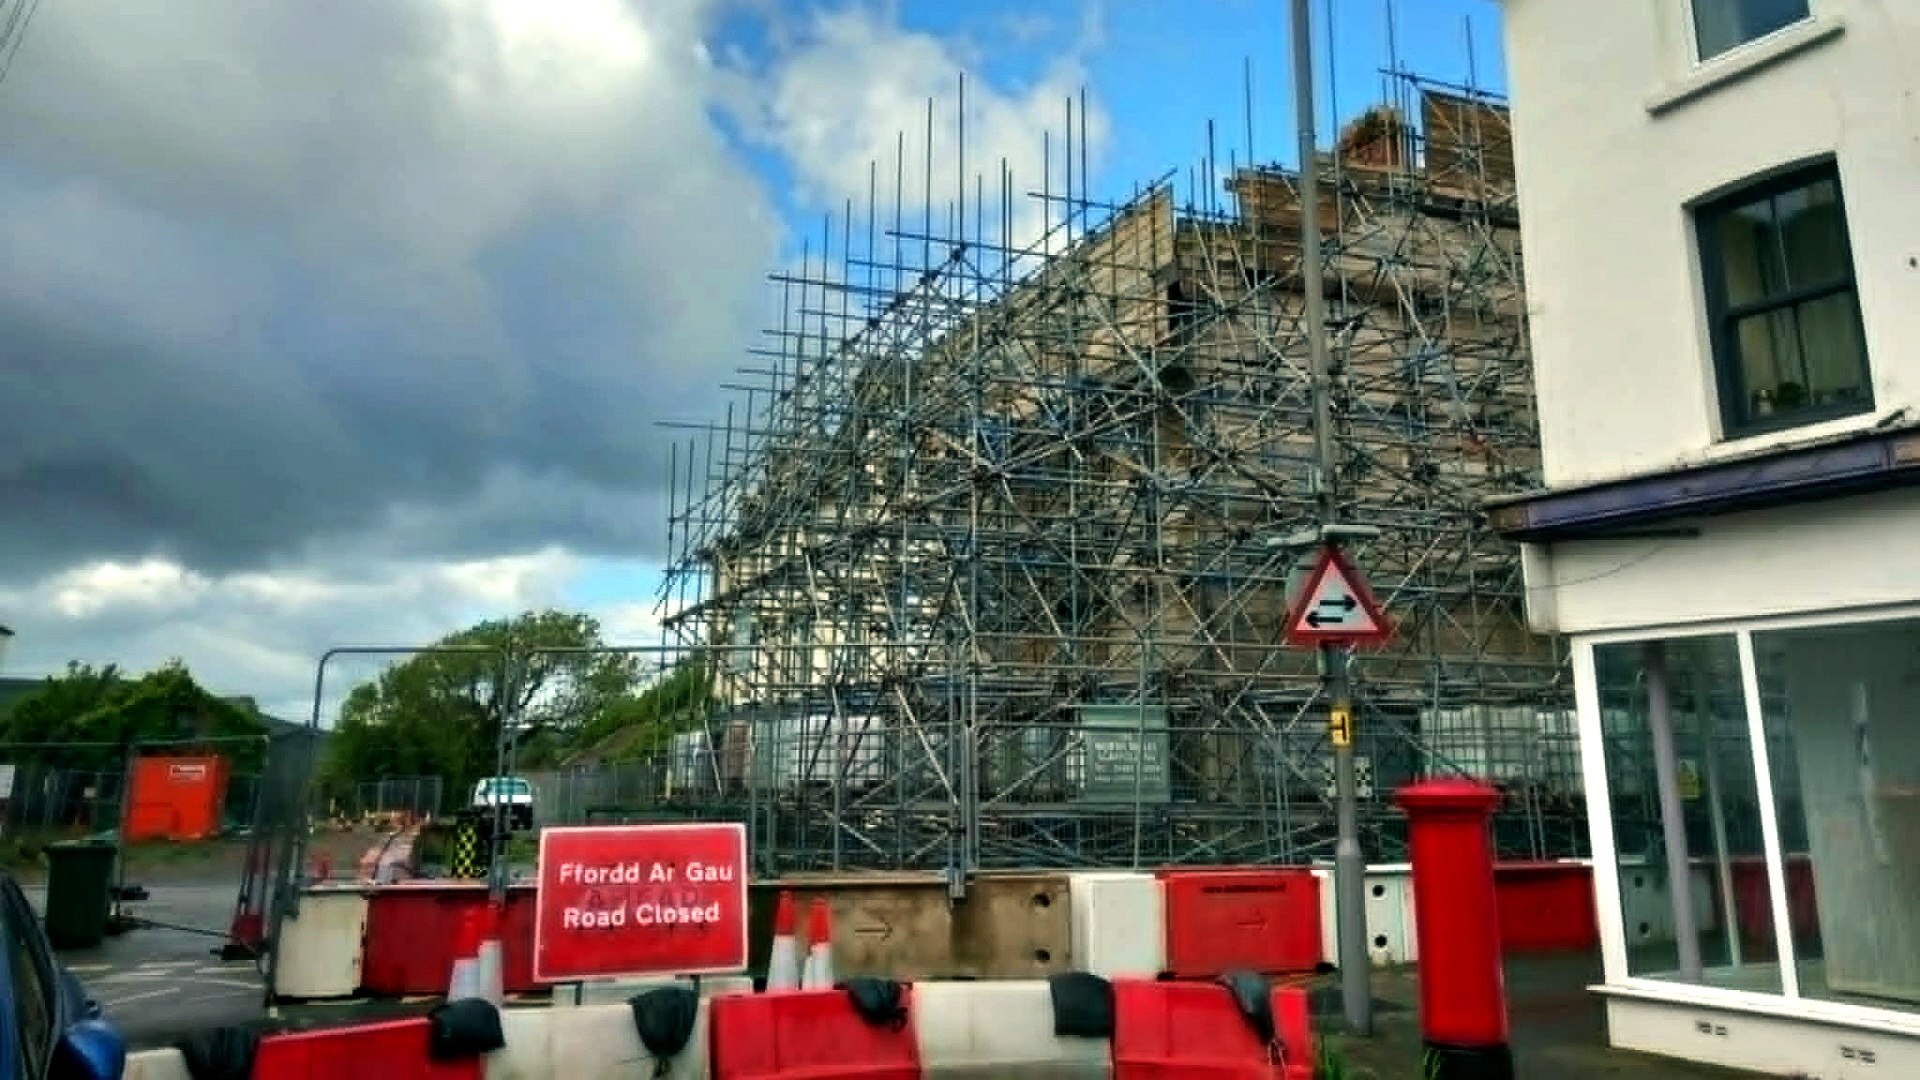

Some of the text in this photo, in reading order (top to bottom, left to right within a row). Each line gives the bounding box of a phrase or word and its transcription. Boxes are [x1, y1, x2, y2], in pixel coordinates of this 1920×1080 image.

[559, 862, 733, 884] Ffordd Ar Gau
[563, 901, 721, 929] Road Closed
